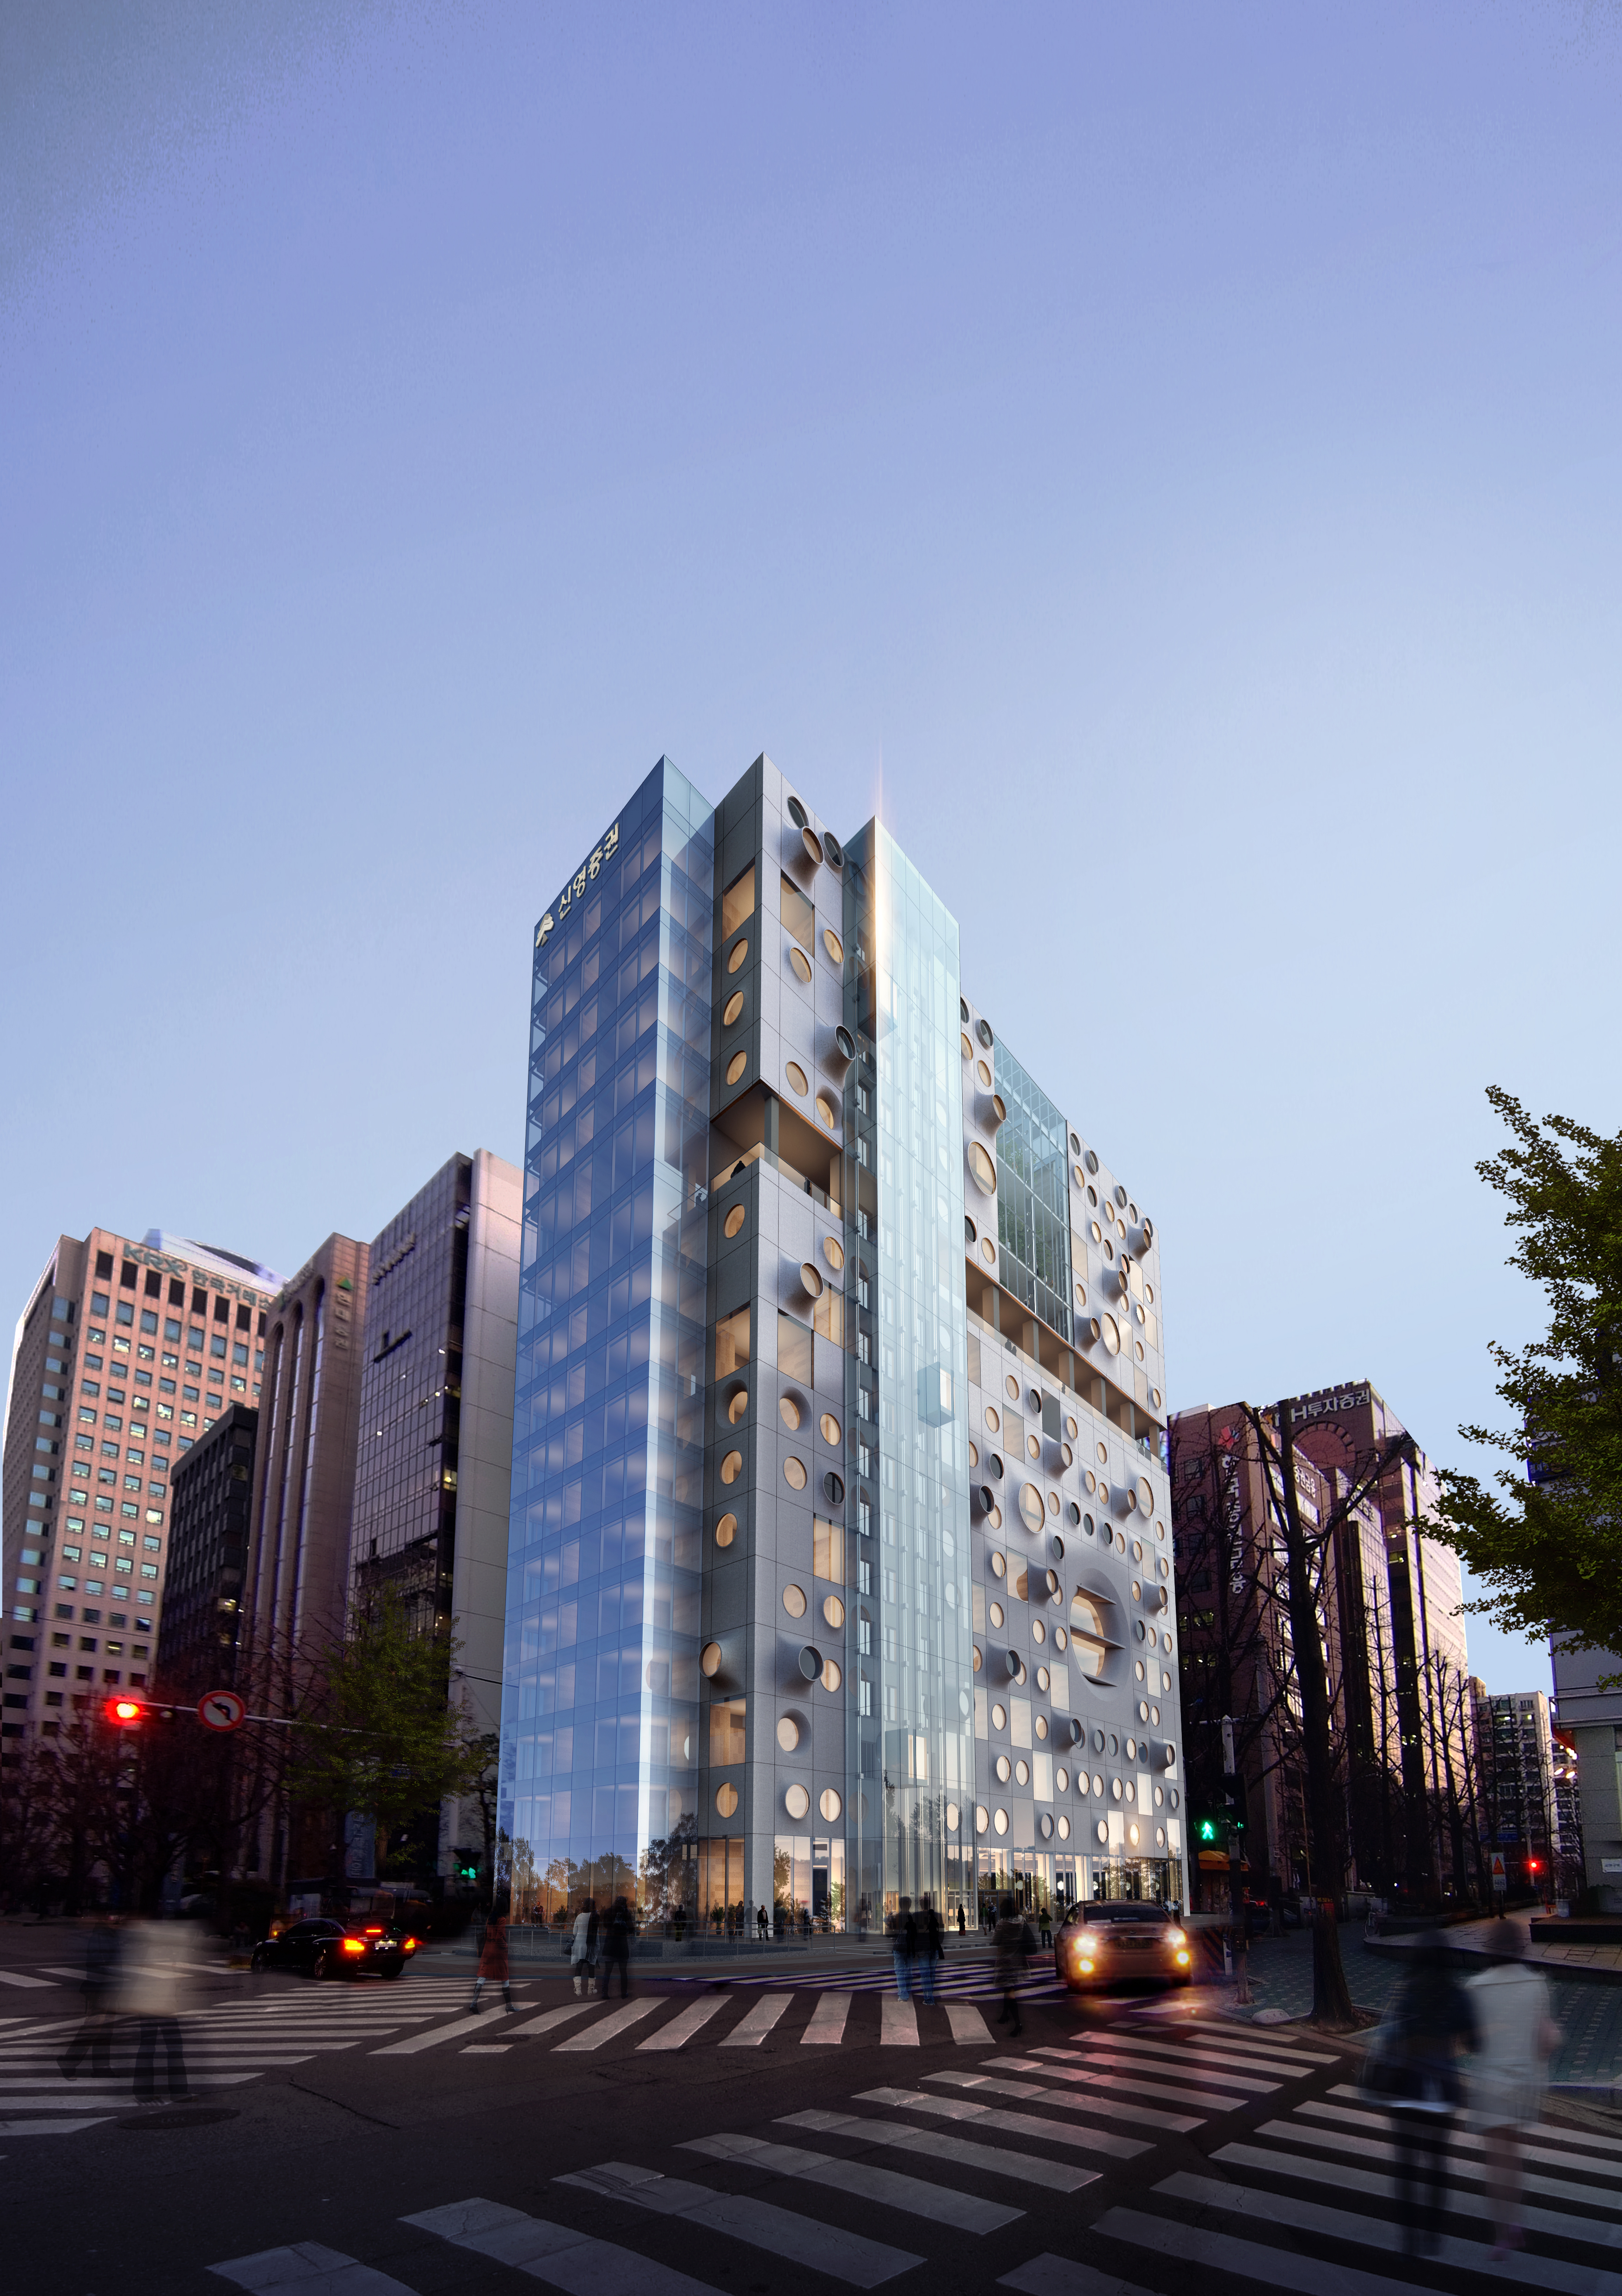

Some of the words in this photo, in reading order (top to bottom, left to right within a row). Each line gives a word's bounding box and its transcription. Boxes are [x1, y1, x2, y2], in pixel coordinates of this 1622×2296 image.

[558, 822, 620, 921] 신영증권
[123, 1243, 188, 1278] KRX
[191, 1269, 271, 1309] 한국거래소
